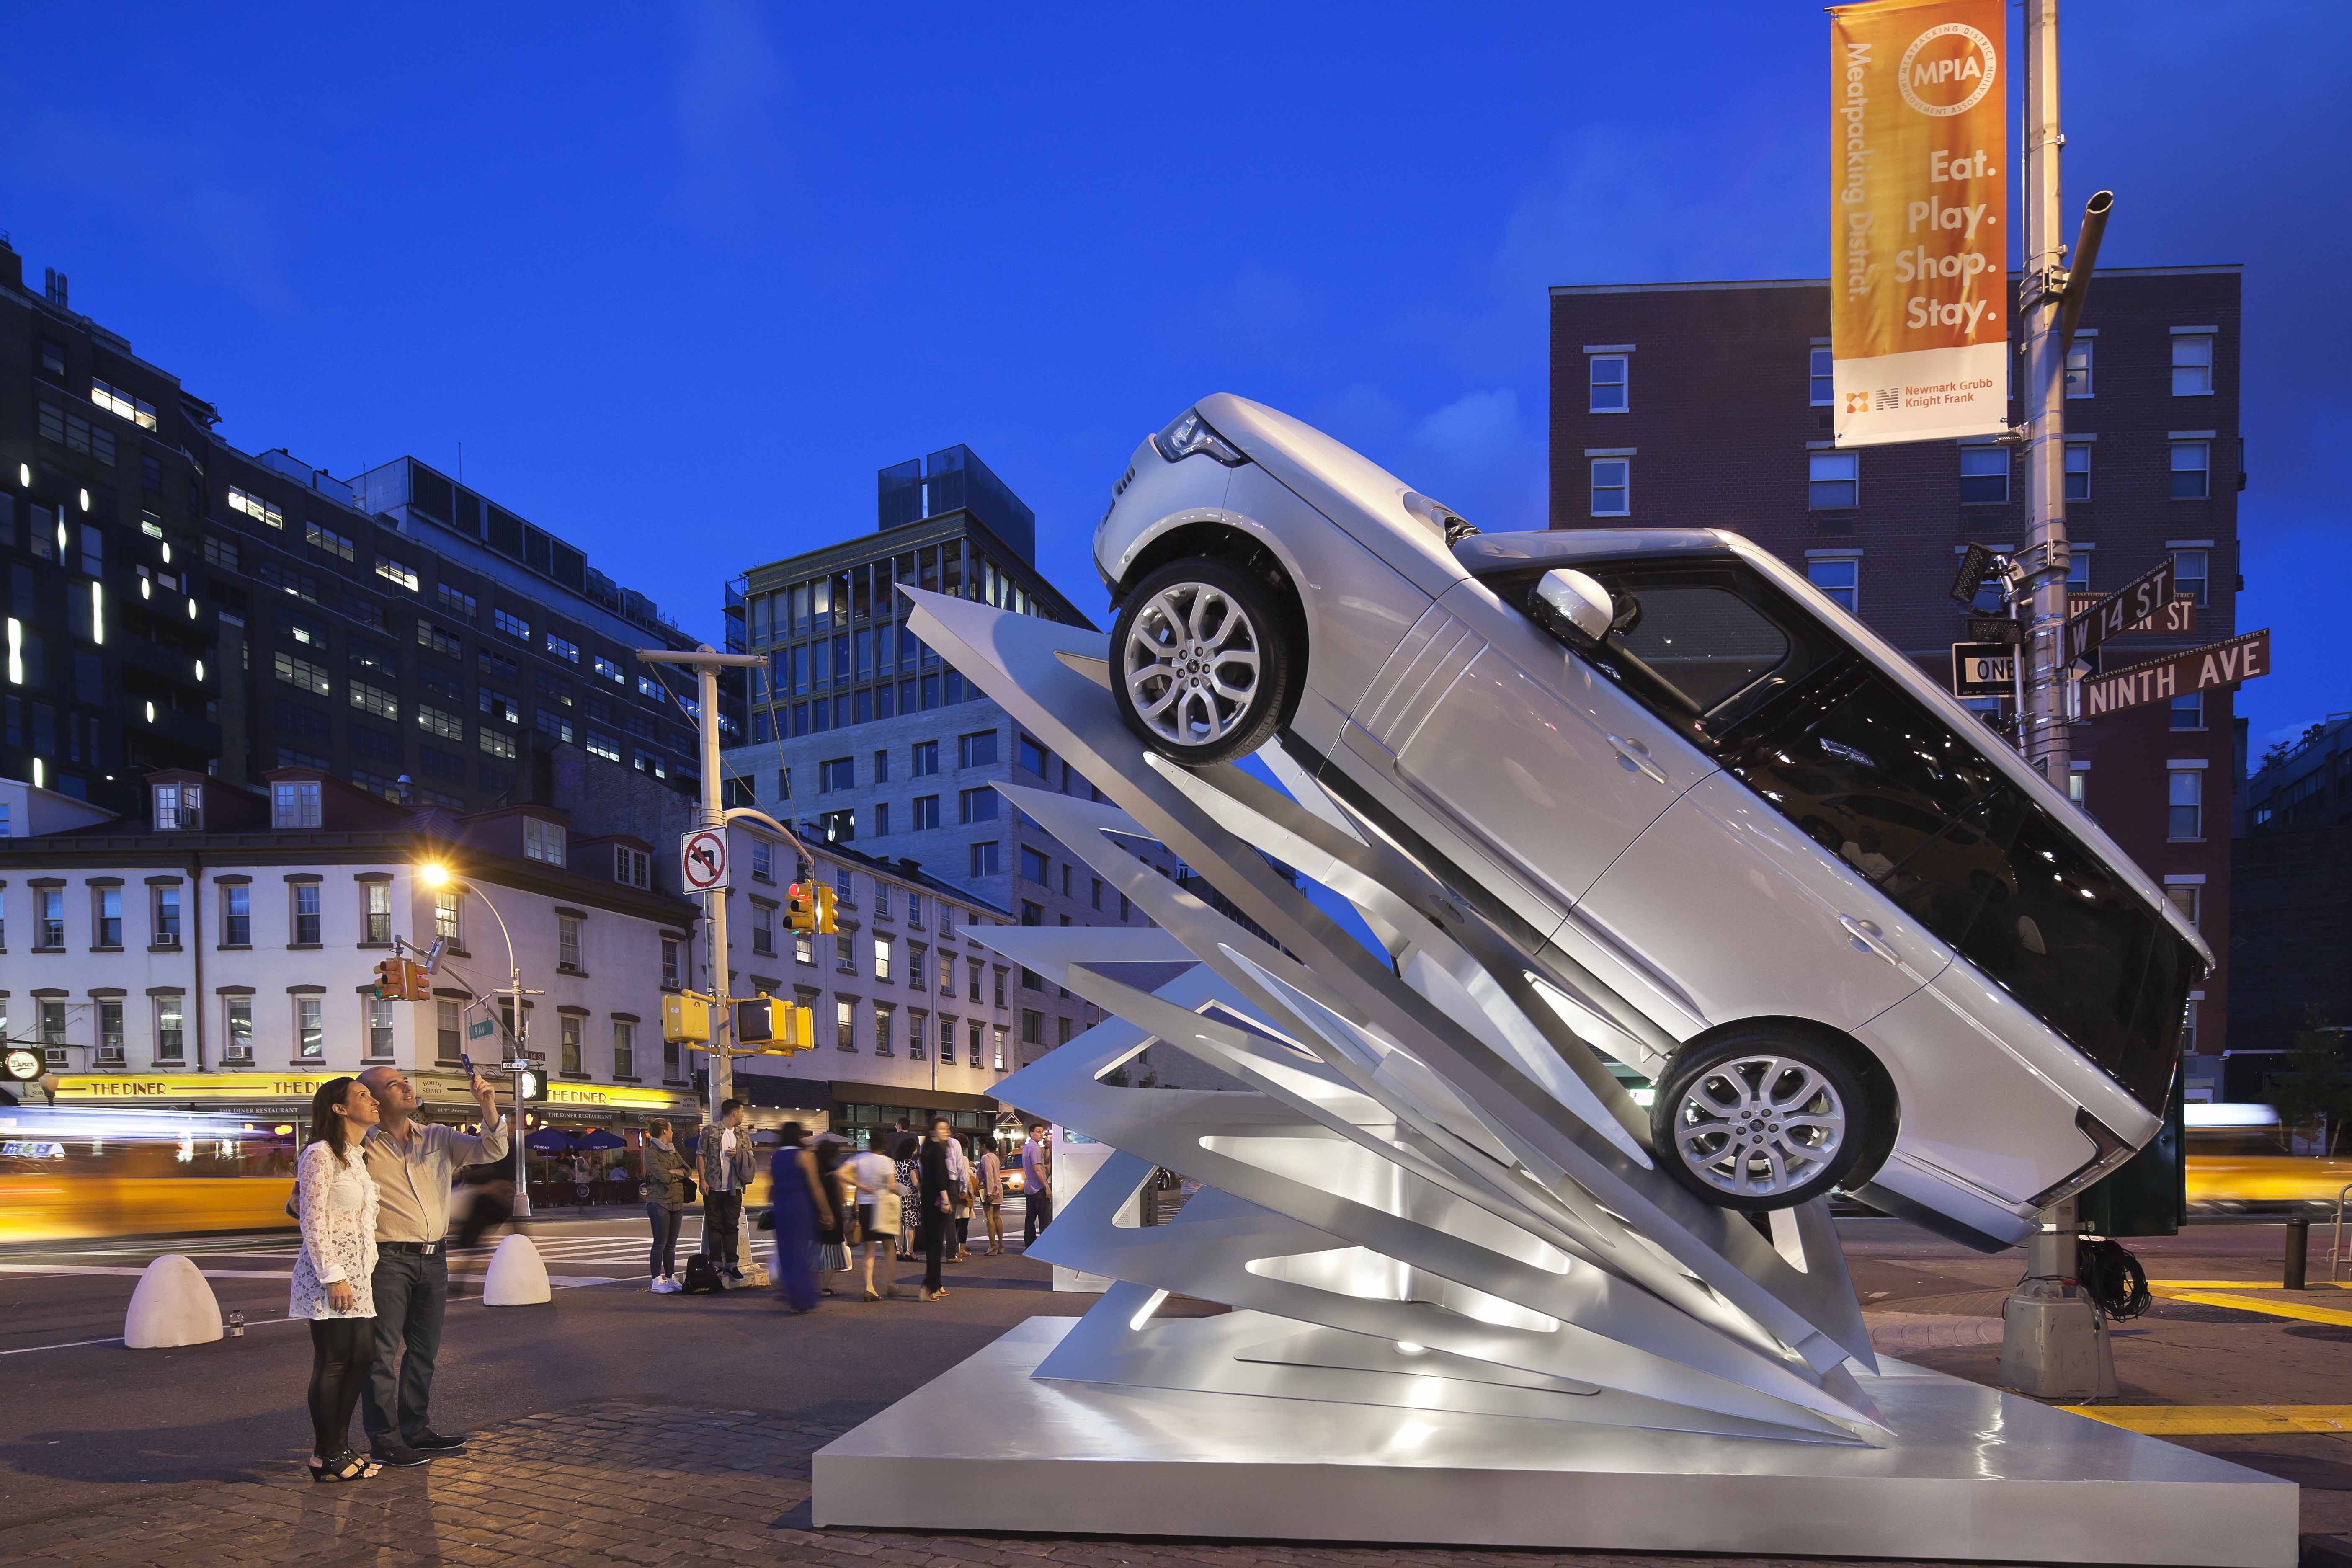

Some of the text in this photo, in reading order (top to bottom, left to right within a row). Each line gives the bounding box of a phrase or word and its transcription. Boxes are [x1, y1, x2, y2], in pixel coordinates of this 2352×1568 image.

[1963, 28, 1994, 60] DISTRICT
[1913, 56, 1982, 87] MPIA
[1951, 66, 1994, 113] ASSOCIATION
[1839, 43, 1875, 204] Meatpacking
[1930, 150, 1996, 183] Eat.
[1908, 195, 1996, 239] Play.
[1895, 245, 1996, 286] Shop.
[1907, 297, 1996, 334] Stay.
[1905, 378, 1993, 396] Newmark Grubb
[1906, 393, 1974, 408] Knight Frank
[2121, 573, 2146, 592] HISTORIC
[2146, 557, 2172, 577] DISTRICT
[2073, 619, 2089, 656] W
[2101, 598, 2124, 640] 14
[2136, 570, 2167, 617] ST
[2167, 601, 2192, 630] ST
[2084, 664, 2139, 683] GANSEVOORT
[2140, 653, 2178, 667] MARKET
[2179, 641, 2224, 658] HISTORIC
[2224, 629, 2268, 645] DISTRICT
[2090, 664, 2175, 715] NINTH
[2197, 641, 2260, 688] AVE
[91, 1083, 166, 1095] THE DINER
[273, 1082, 302, 1093] THE
[547, 1090, 606, 1104] THE DINER
